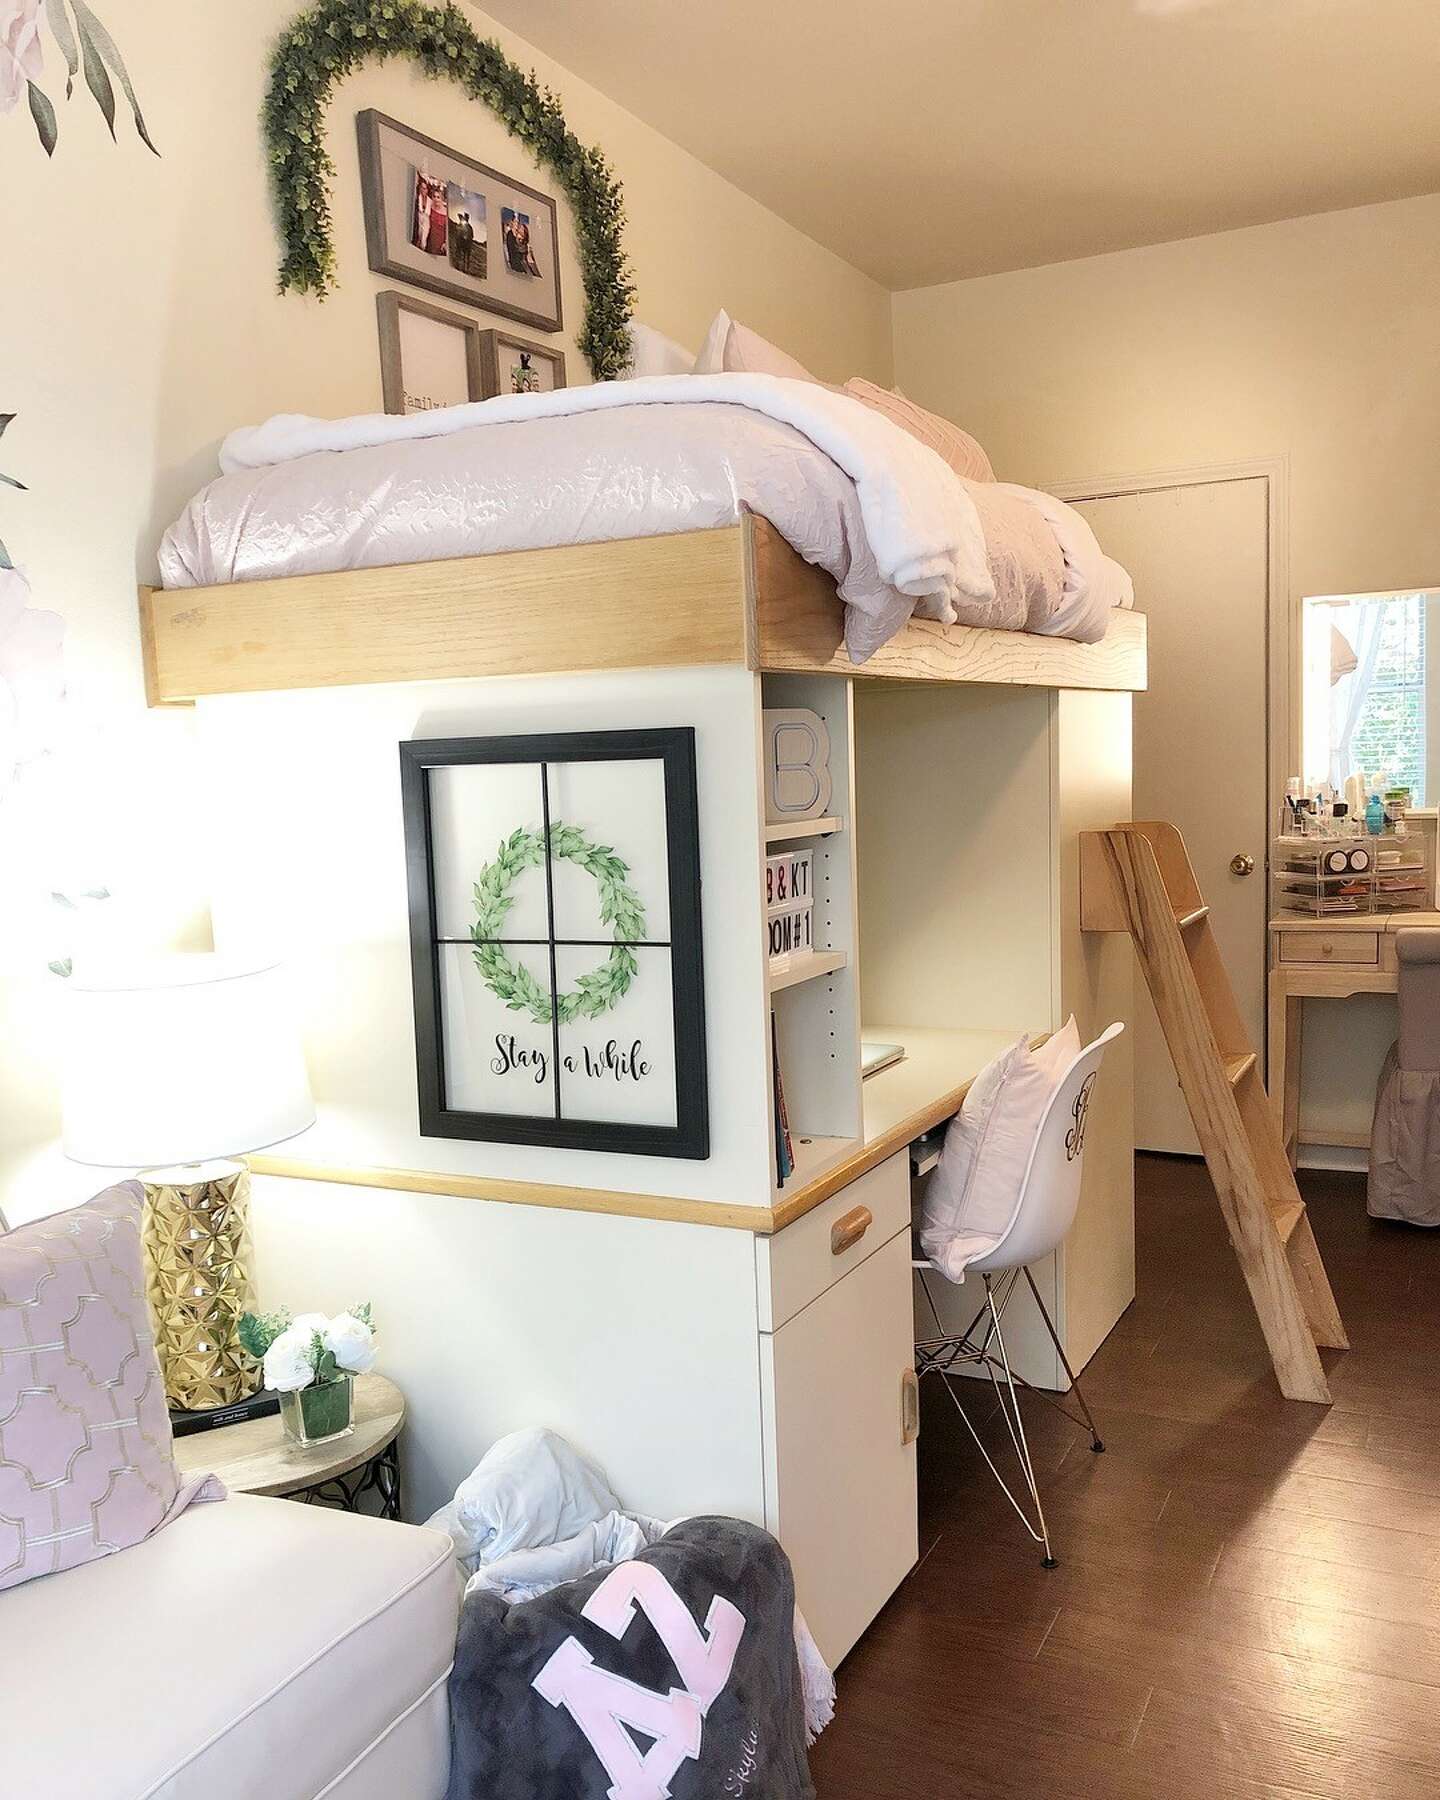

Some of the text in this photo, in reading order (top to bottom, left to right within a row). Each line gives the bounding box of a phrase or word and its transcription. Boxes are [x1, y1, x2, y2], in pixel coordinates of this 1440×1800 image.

[791, 861, 808, 898] KT
[490, 1033, 653, 1084] Stay a While
